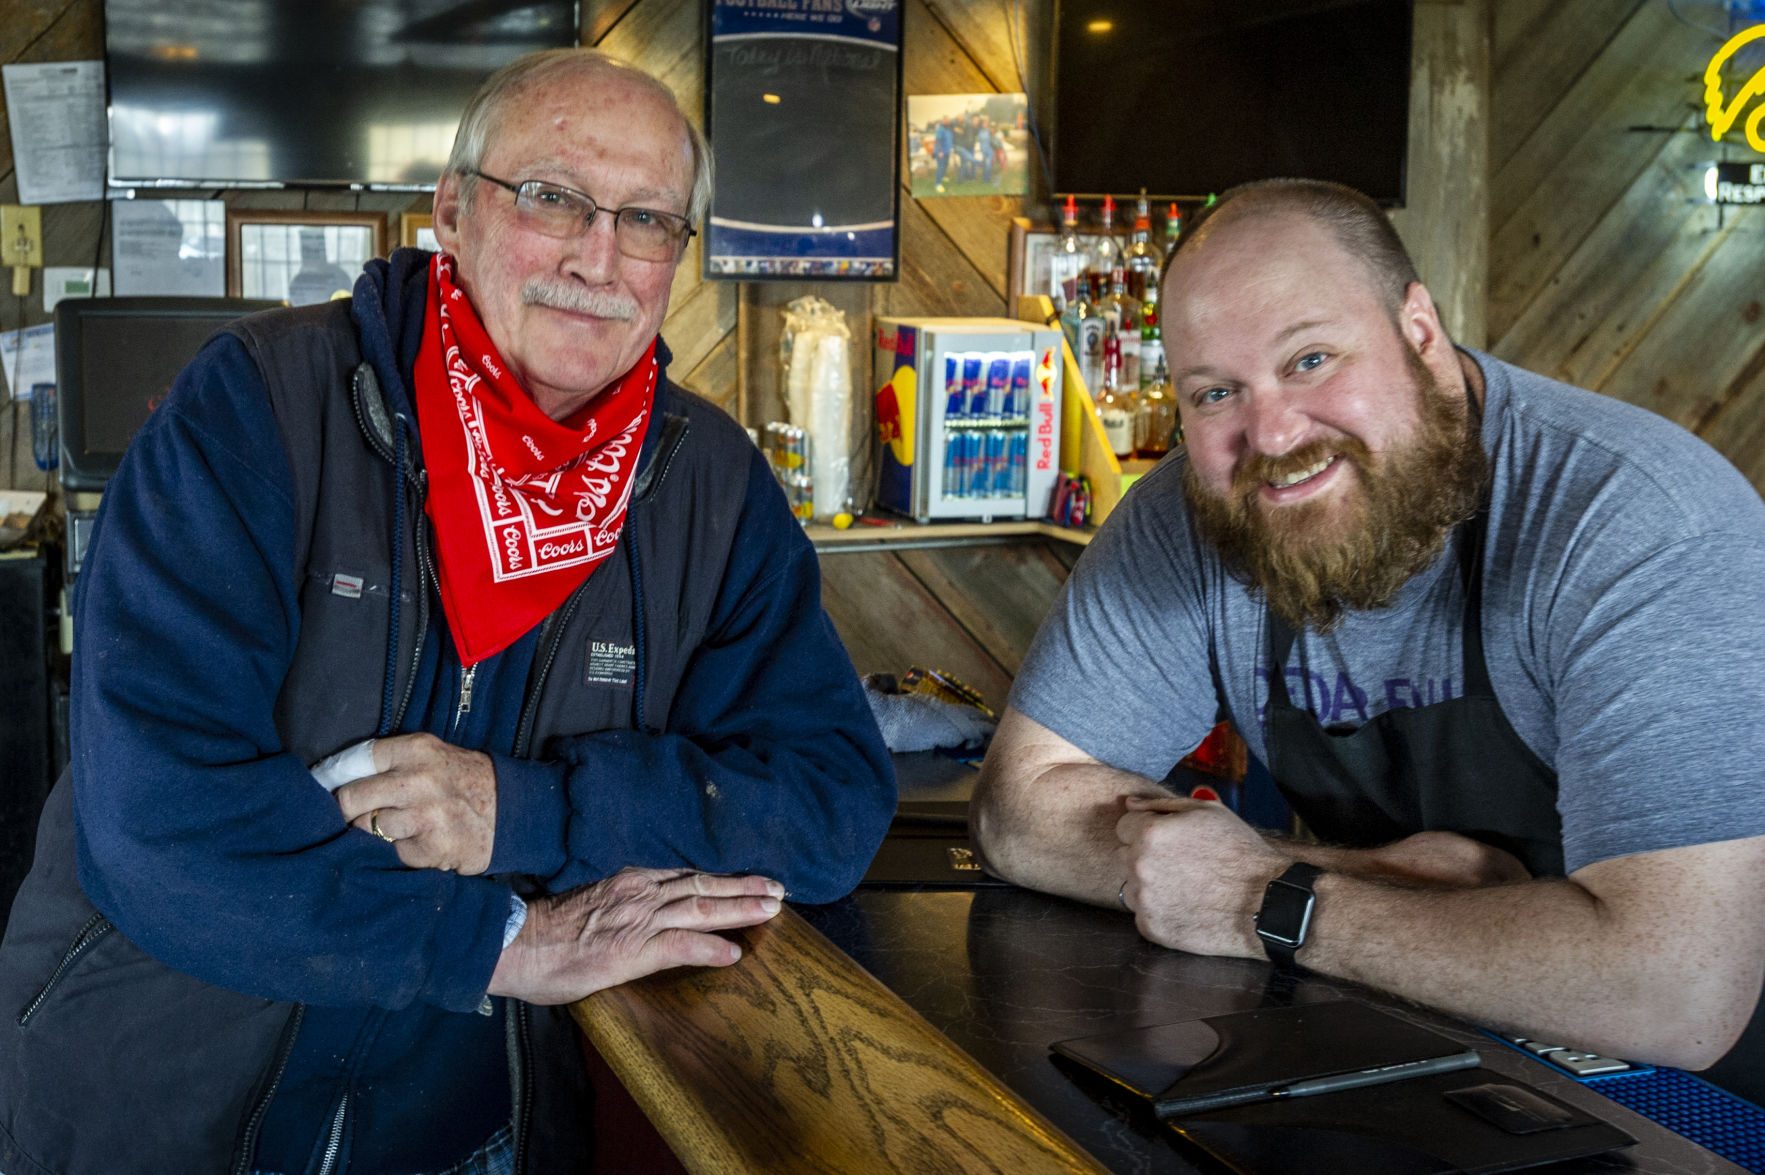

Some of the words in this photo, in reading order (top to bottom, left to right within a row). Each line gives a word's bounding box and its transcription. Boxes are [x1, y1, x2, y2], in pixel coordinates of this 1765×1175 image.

[481, 354, 502, 380] Coors
[1037, 402, 1054, 435] Bull
[521, 434, 546, 462] Coors
[1037, 437, 1054, 471] Red
[502, 524, 524, 571] Coors
[538, 538, 584, 560] Coors
